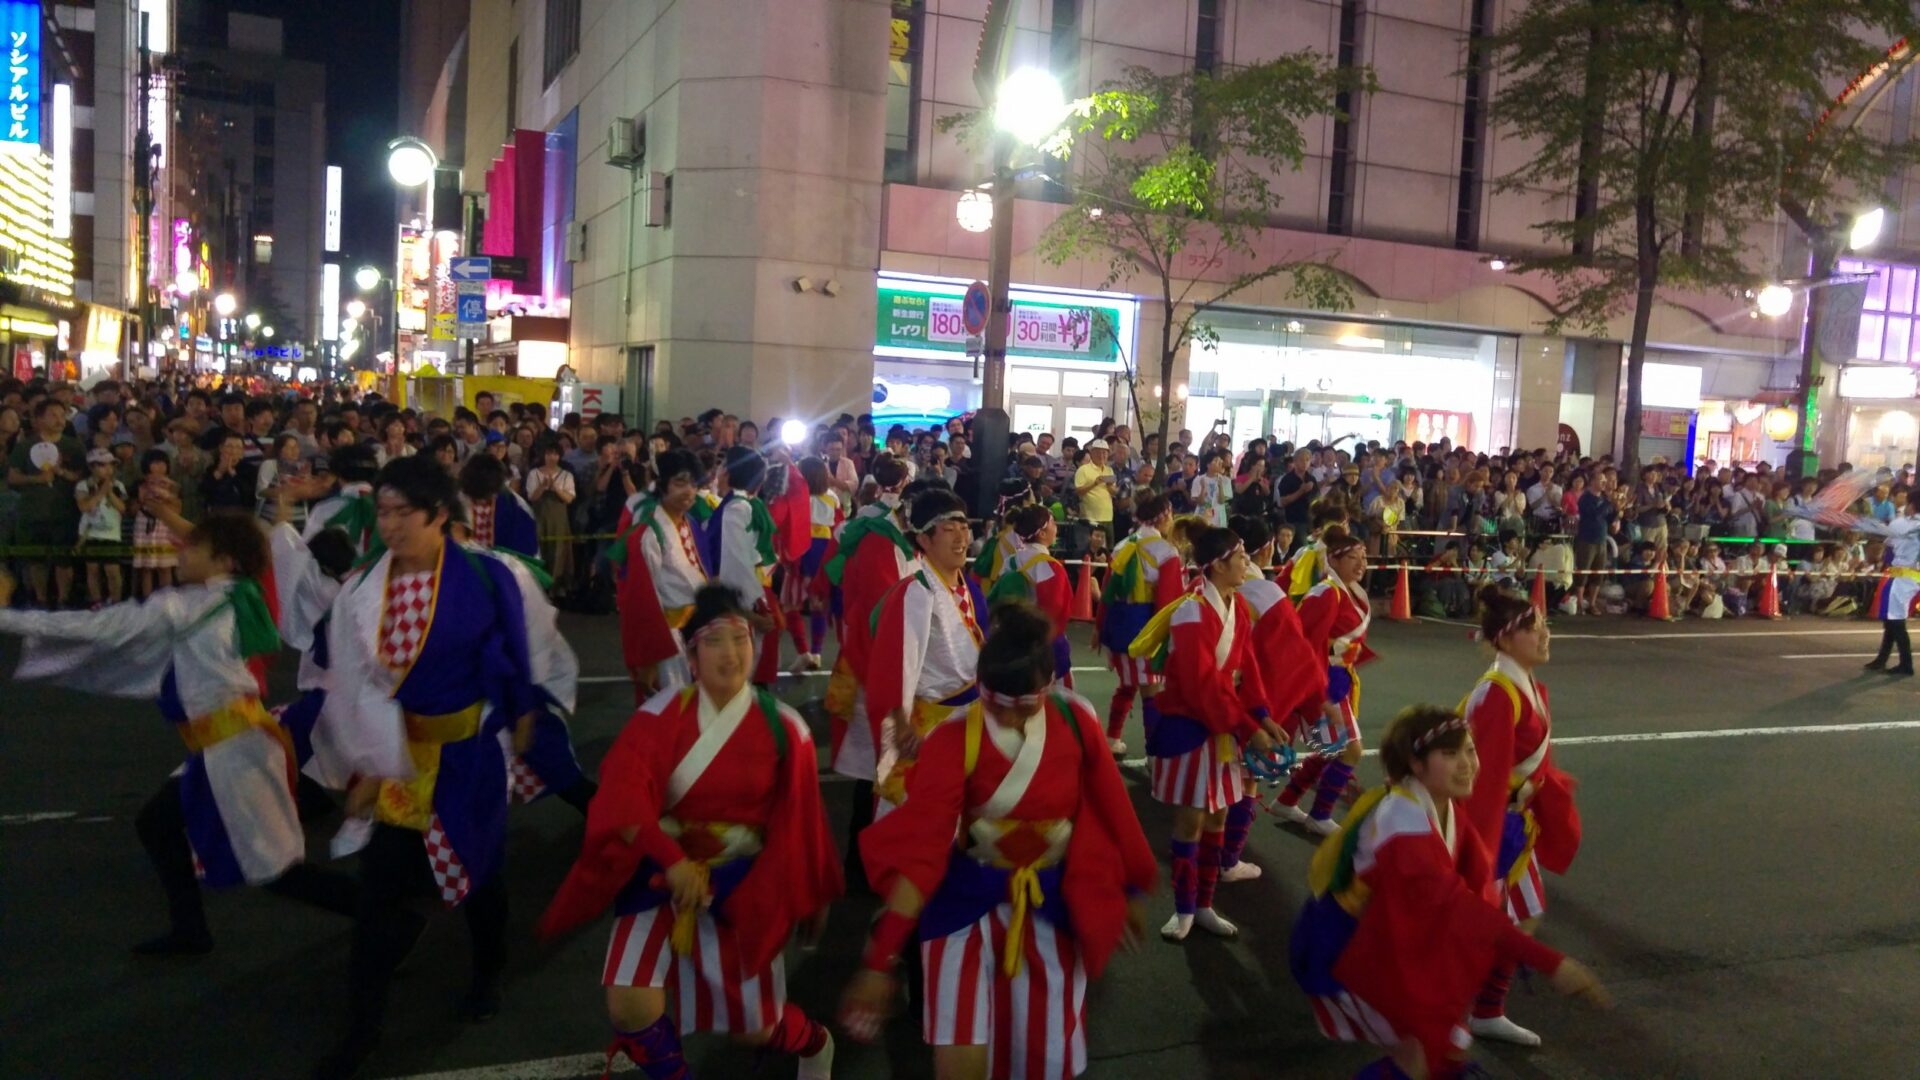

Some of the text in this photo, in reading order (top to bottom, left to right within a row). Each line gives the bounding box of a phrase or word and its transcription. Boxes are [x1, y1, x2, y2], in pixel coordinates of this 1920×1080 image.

[9, 31, 29, 139] ソシアルビル
[462, 299, 482, 318] 停
[932, 313, 961, 335] 180
[1017, 320, 1040, 342] 30
[1041, 321, 1057, 332] 日間
